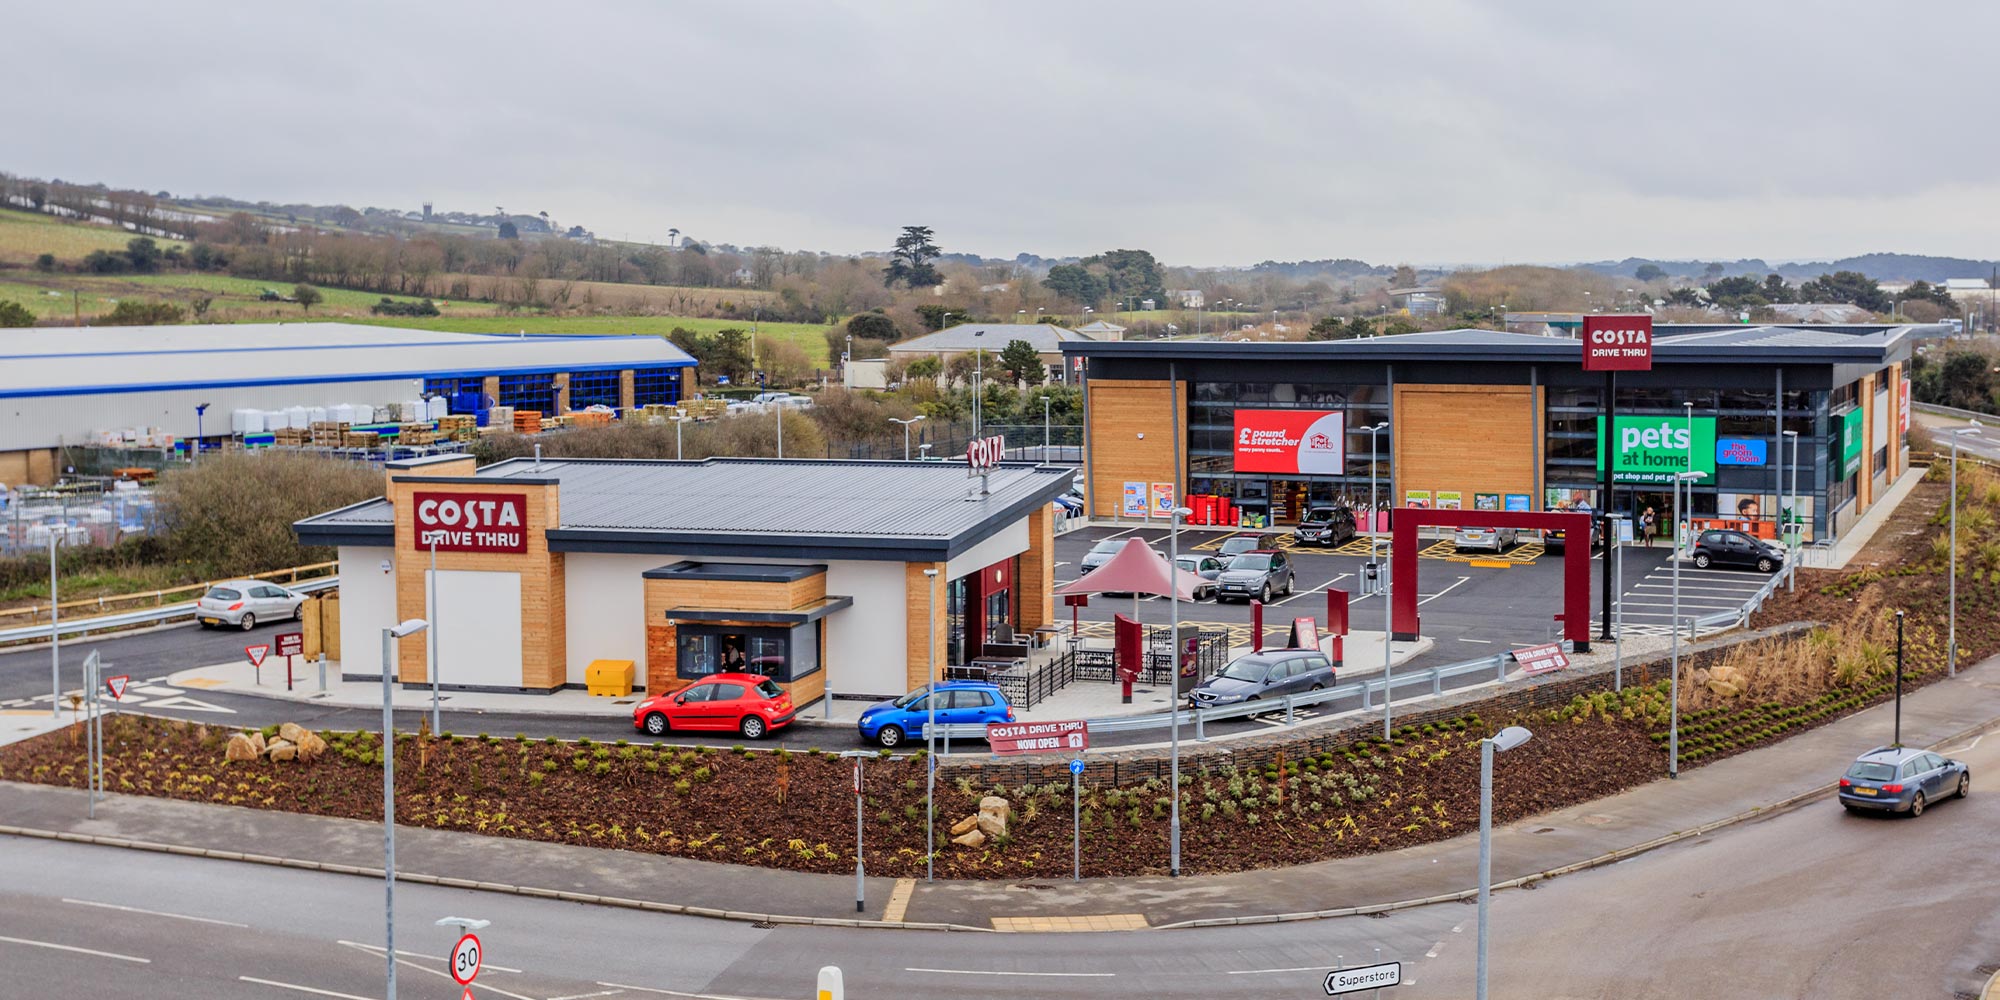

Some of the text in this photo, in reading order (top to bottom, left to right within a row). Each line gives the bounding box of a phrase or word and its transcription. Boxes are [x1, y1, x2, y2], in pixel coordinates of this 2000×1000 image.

[1592, 329, 1647, 345] COSTA
[1592, 348, 1647, 357] DRIVE THRU
[1251, 437, 1299, 446] stretcher
[1252, 429, 1286, 438] pound
[1622, 422, 1689, 453] pets
[970, 435, 1006, 468] COSTA
[1722, 450, 1753, 458] groom
[1731, 442, 1746, 451] the
[1622, 450, 1689, 467] at home
[1735, 455, 1760, 463] room
[1613, 473, 1624, 481] pet
[1625, 473, 1640, 481] shop
[1655, 474, 1665, 482] pet
[418, 499, 520, 529] COSTA
[421, 530, 519, 547] DRIVE THRU
[991, 721, 1084, 737] COSTA DRIVE THRU
[1017, 737, 1060, 750] NOW OPEN
[457, 947, 477, 972] 30
[1339, 971, 1395, 987] Superstore
